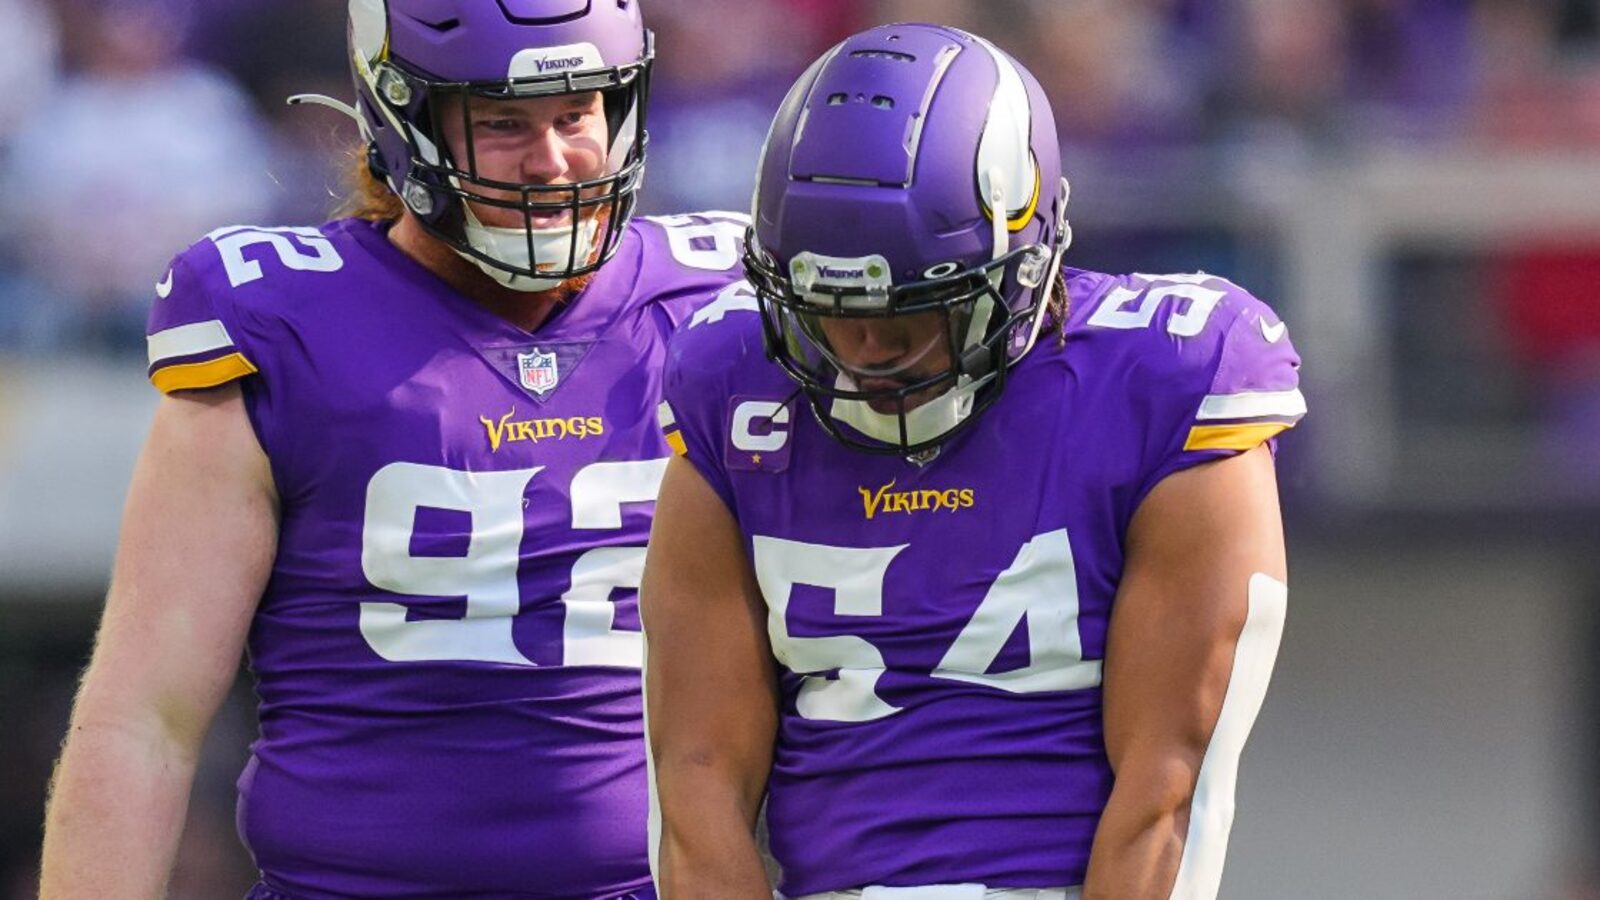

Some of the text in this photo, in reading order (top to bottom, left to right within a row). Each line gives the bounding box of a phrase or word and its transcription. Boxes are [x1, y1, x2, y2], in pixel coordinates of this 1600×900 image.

[208, 225, 344, 288] 2
[1087, 271, 1228, 337] 5
[731, 401, 790, 452] C
[359, 457, 671, 668] 92
[752, 527, 1103, 722] 54
